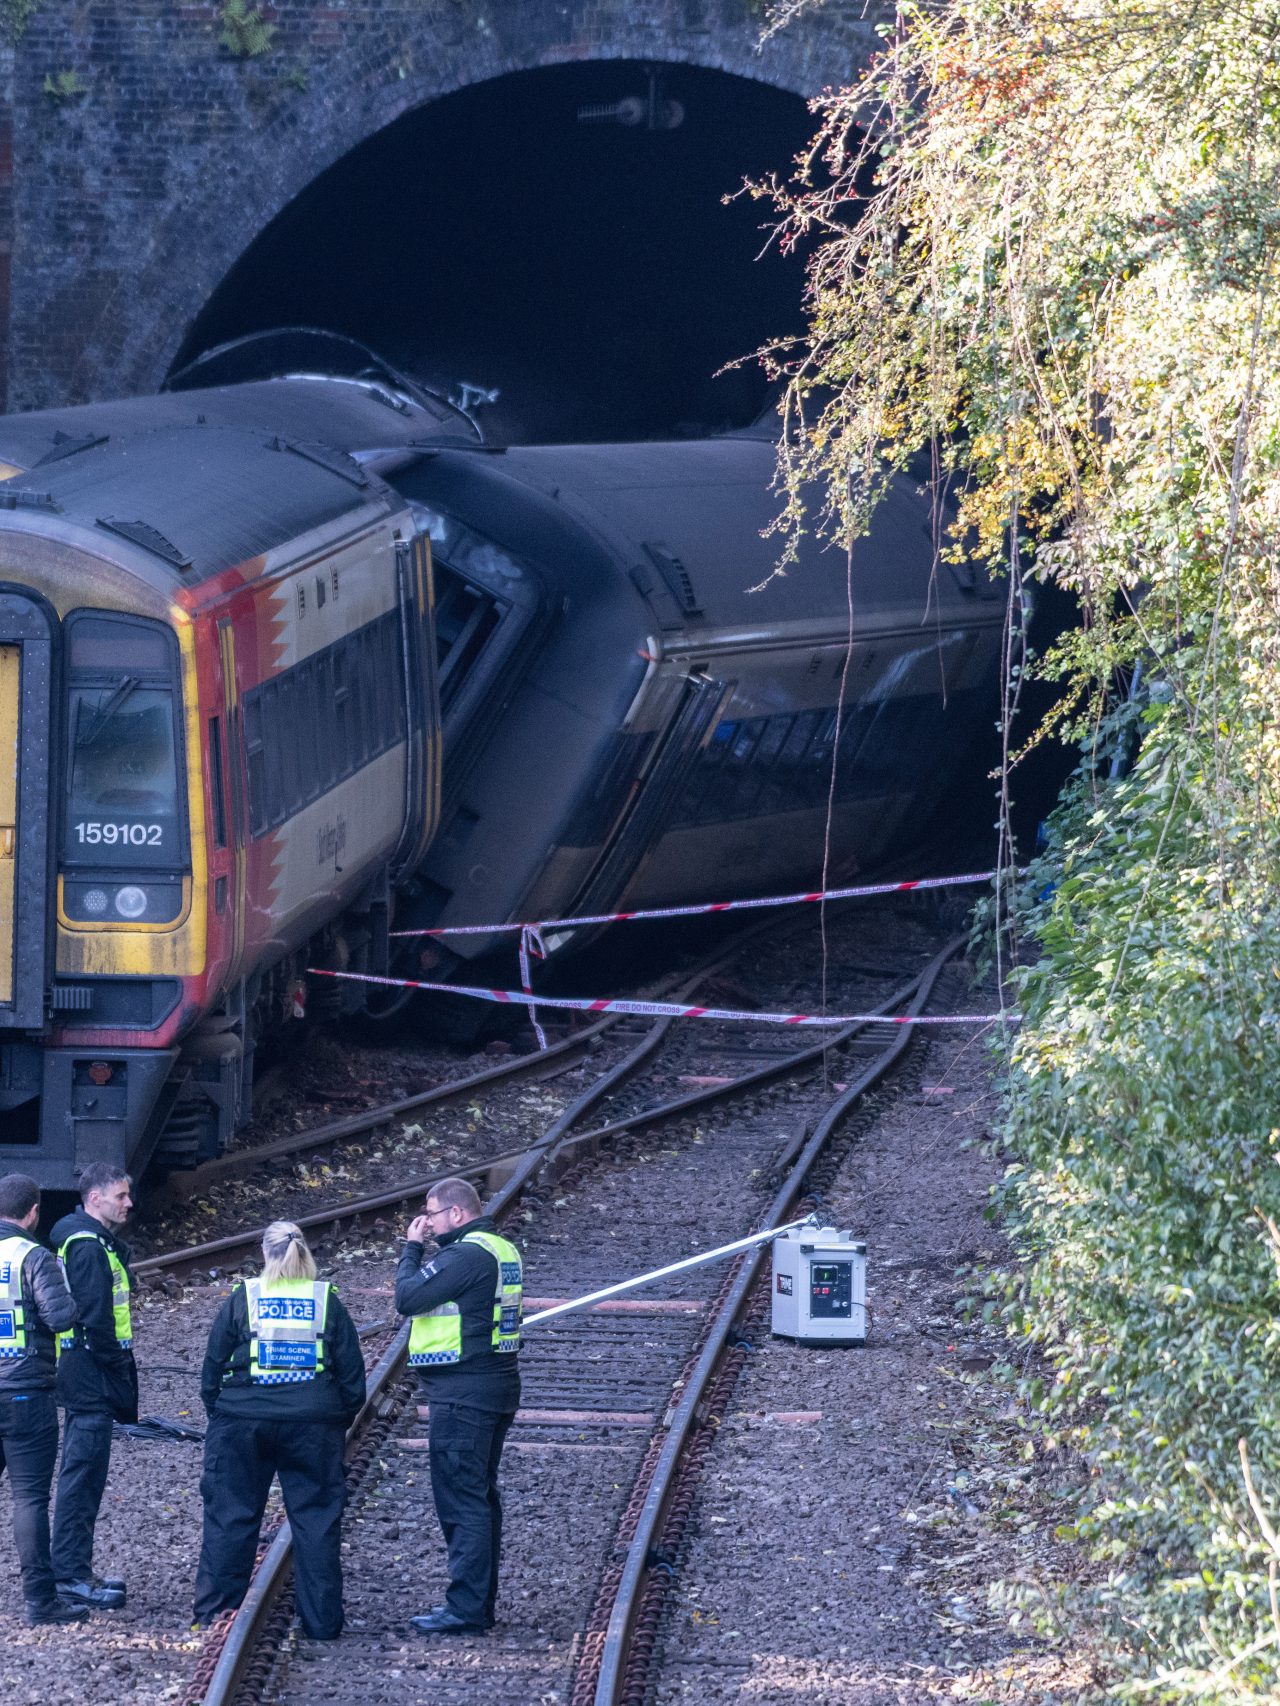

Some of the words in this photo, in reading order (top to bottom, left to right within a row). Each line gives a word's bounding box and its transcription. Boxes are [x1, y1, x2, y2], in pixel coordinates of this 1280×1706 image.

[74, 822, 163, 846] 159102
[615, 1003, 630, 1012] FIRE
[631, 1004, 642, 1012] DO
[643, 1004, 656, 1013] NOT
[657, 1005, 680, 1014] CROSS
[259, 1305, 313, 1318] POLICE
[287, 1346, 311, 1354] SCENE
